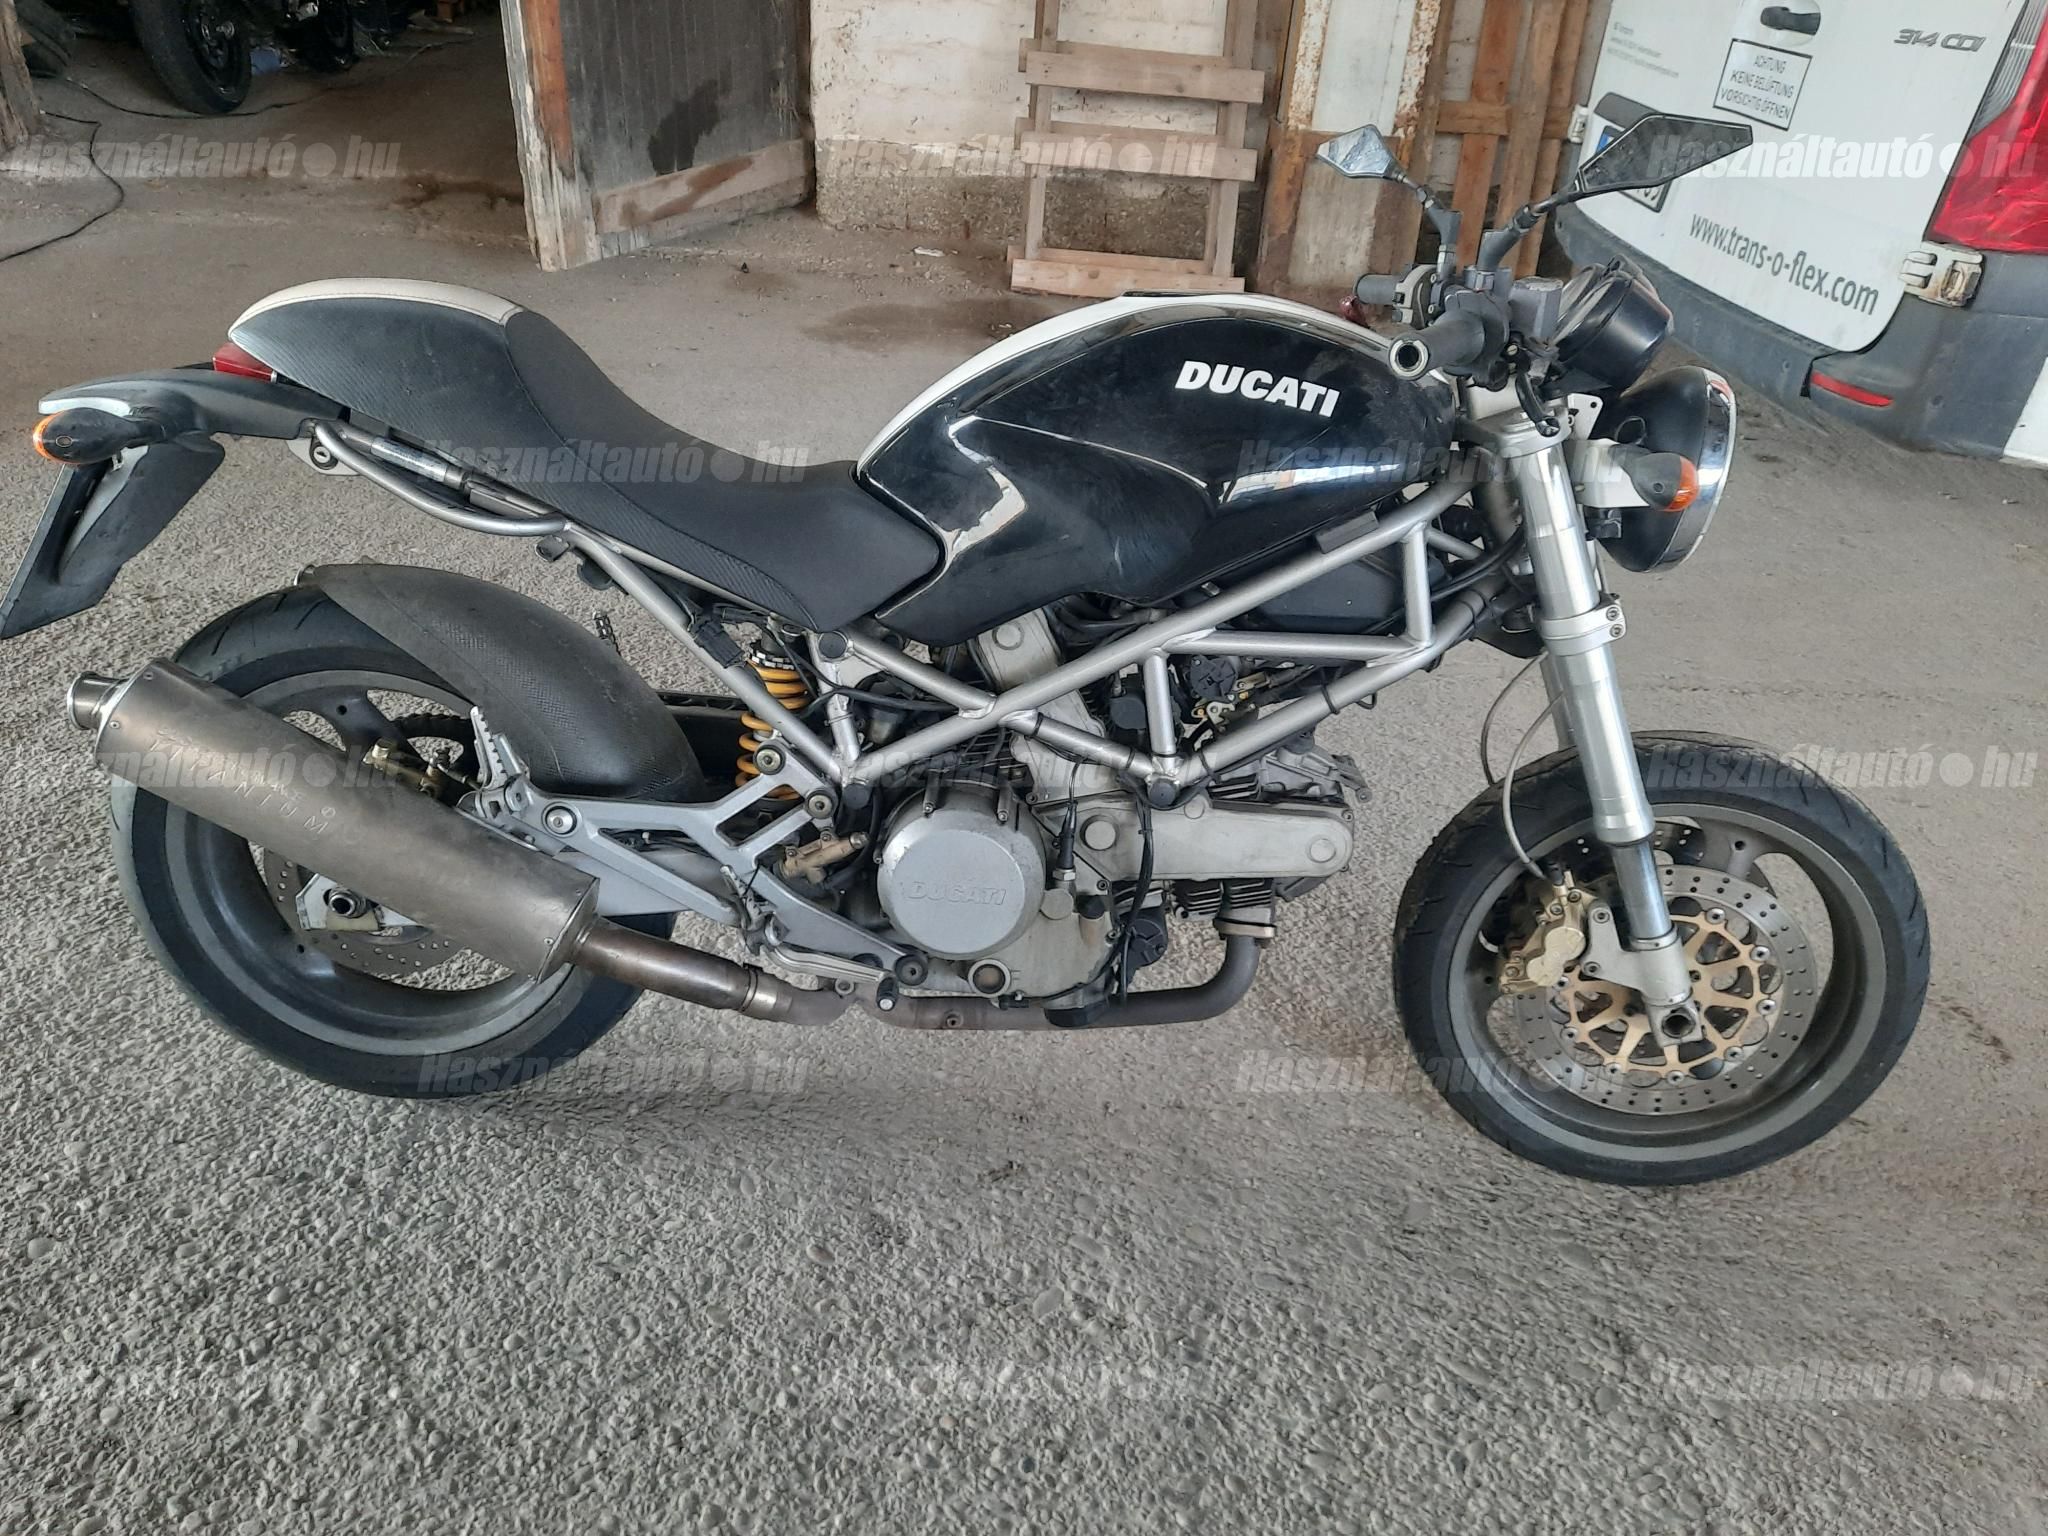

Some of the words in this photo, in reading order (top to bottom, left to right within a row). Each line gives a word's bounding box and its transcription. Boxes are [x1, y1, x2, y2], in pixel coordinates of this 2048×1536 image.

[1893, 28, 1939, 48] 314
[1940, 33, 1987, 52] CDI
[1754, 55, 1787, 74] ACHTUNG
[1730, 70, 1755, 87] KEINE
[1688, 212, 1880, 316] www.trans-o-flex.com
[1174, 359, 1340, 418] DUCATI
[906, 881, 1007, 906] DUCATI
